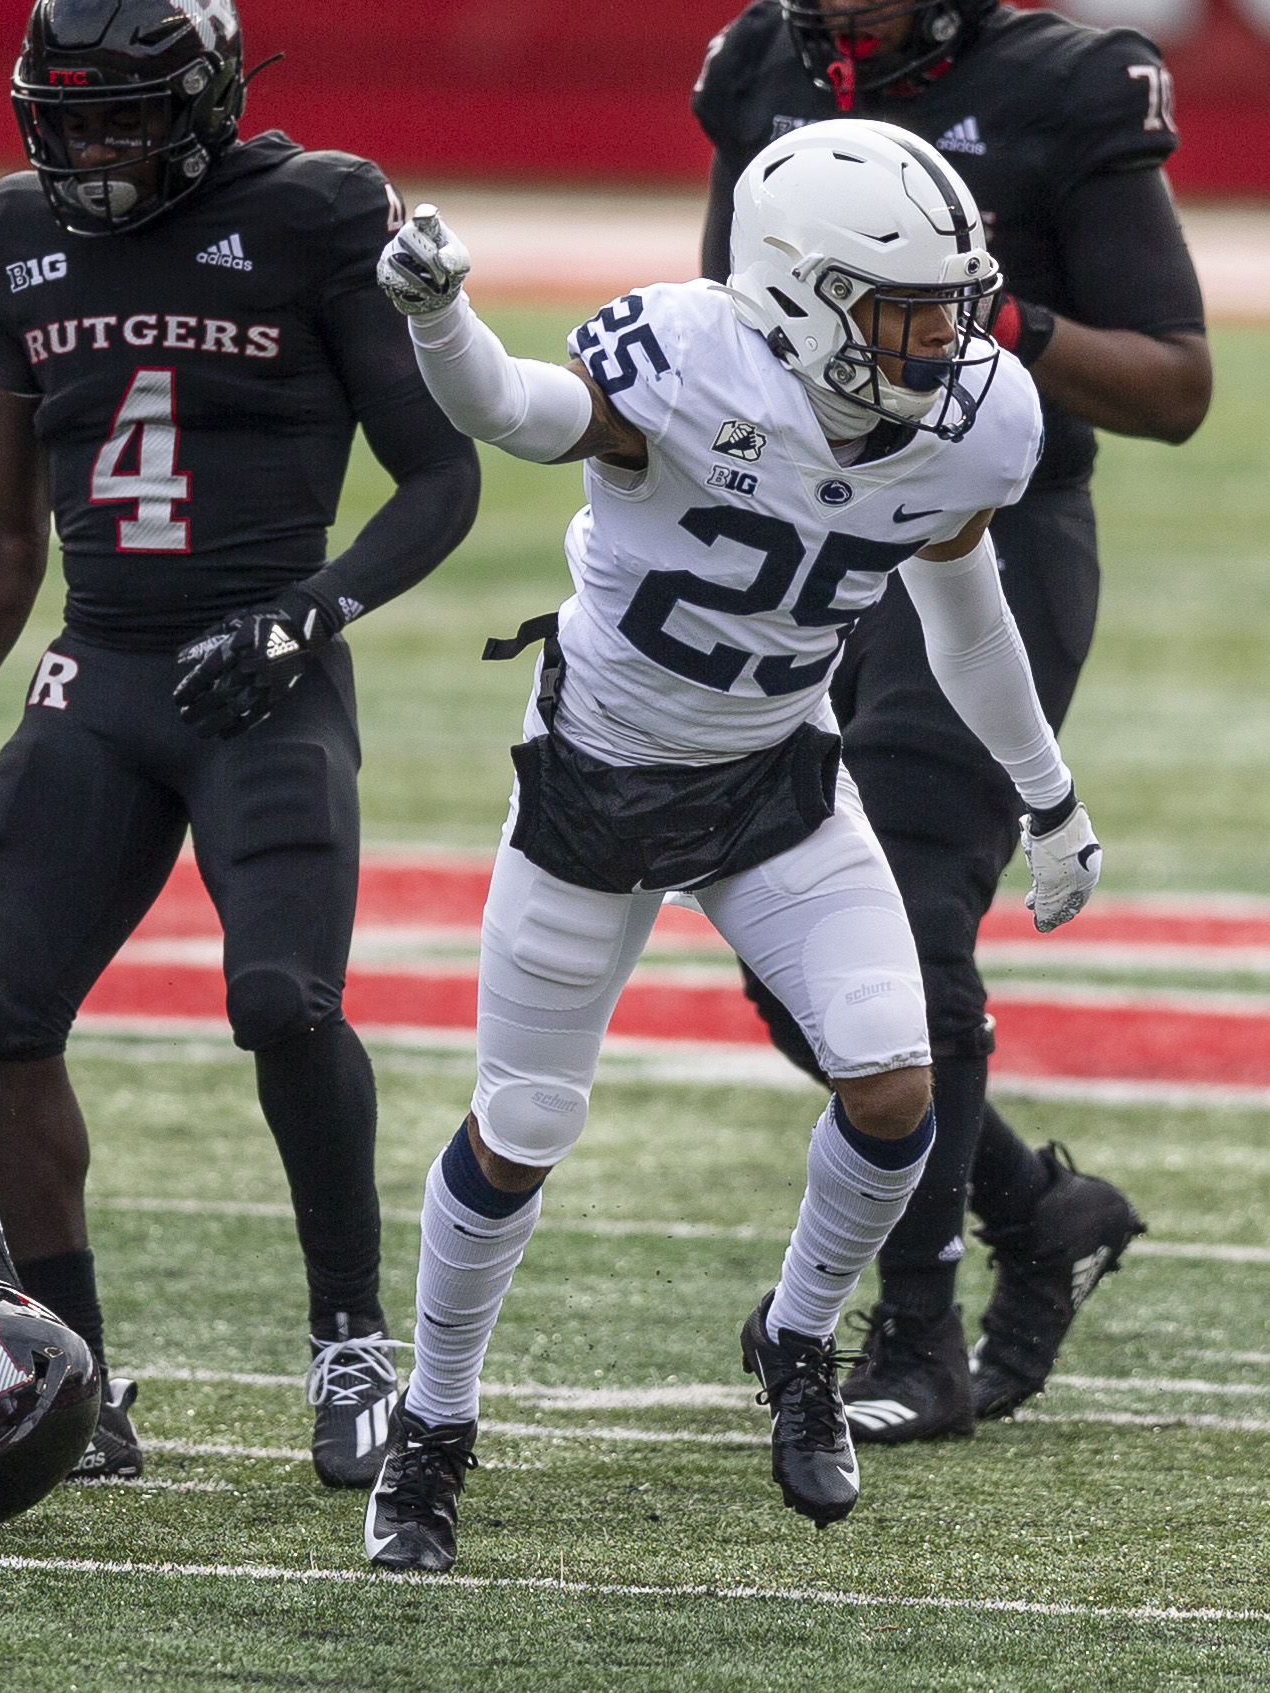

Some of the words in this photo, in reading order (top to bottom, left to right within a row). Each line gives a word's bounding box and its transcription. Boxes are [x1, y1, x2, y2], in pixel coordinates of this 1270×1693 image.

[196, 250, 253, 272] adidas
[25, 313, 281, 364] RUTGERS
[576, 294, 671, 396] 25
[89, 366, 192, 553] 4
[617, 505, 928, 698] 25
[28, 650, 79, 711] R
